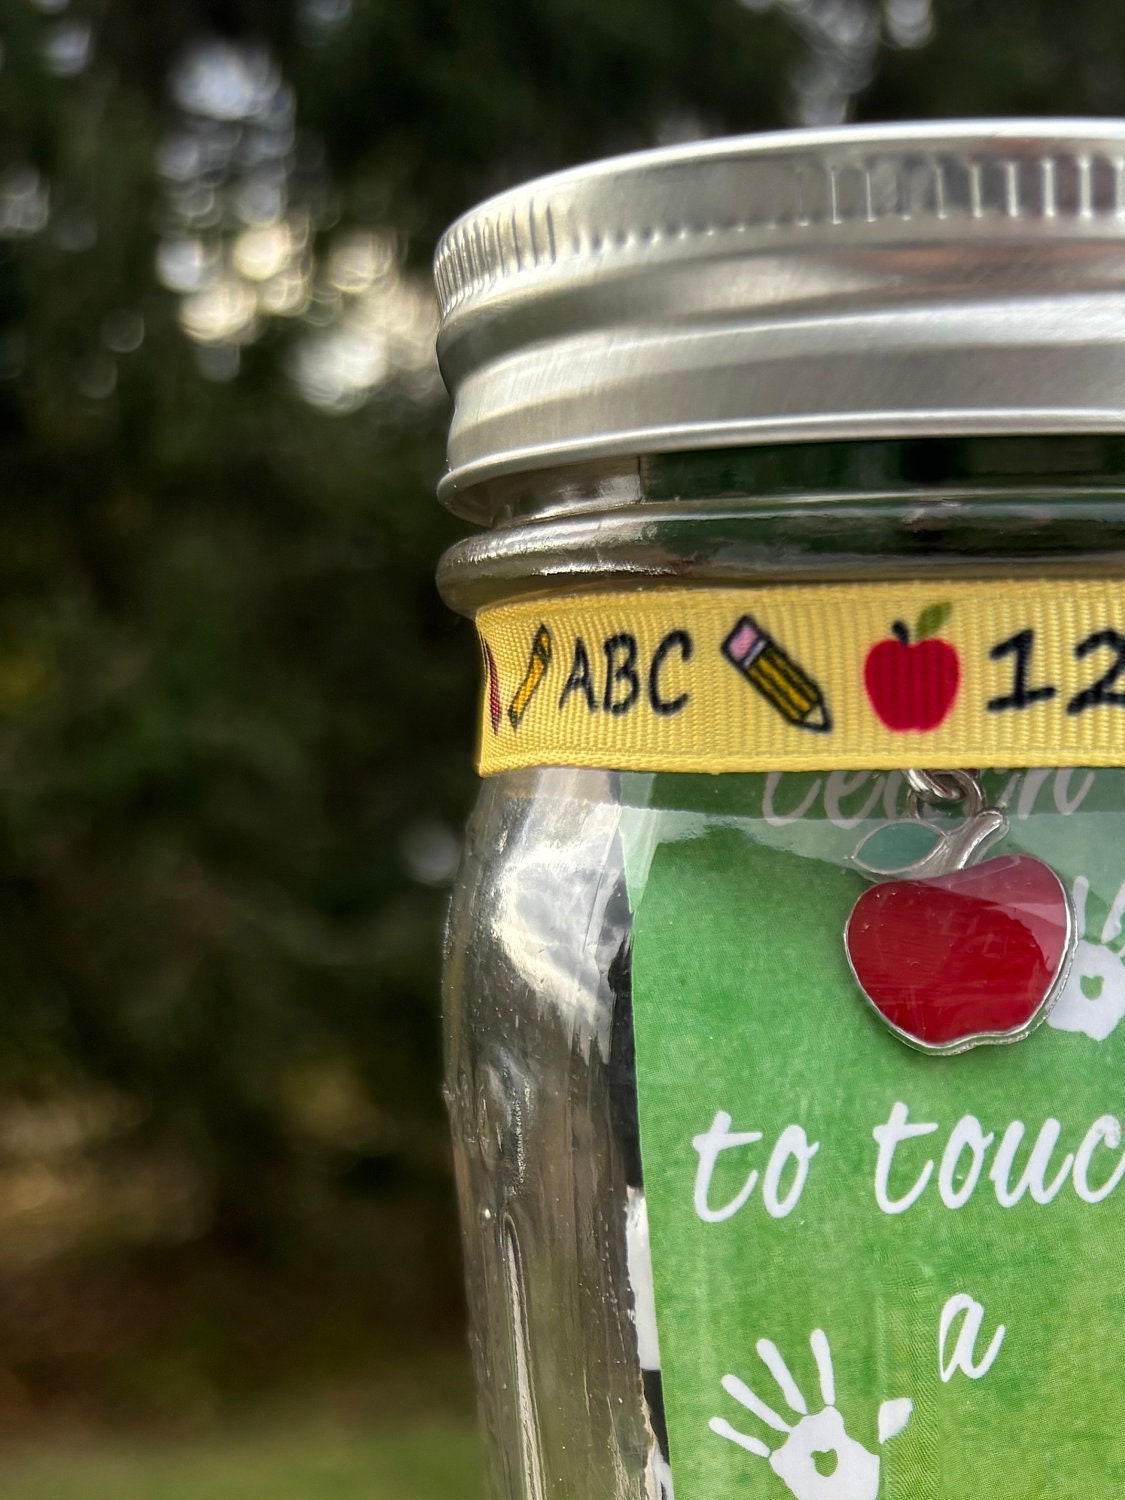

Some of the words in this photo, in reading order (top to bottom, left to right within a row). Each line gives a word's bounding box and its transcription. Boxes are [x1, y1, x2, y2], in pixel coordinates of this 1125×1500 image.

[558, 629, 693, 716] ABC
[691, 1110, 820, 1223] to
[938, 1293, 1006, 1383] a
